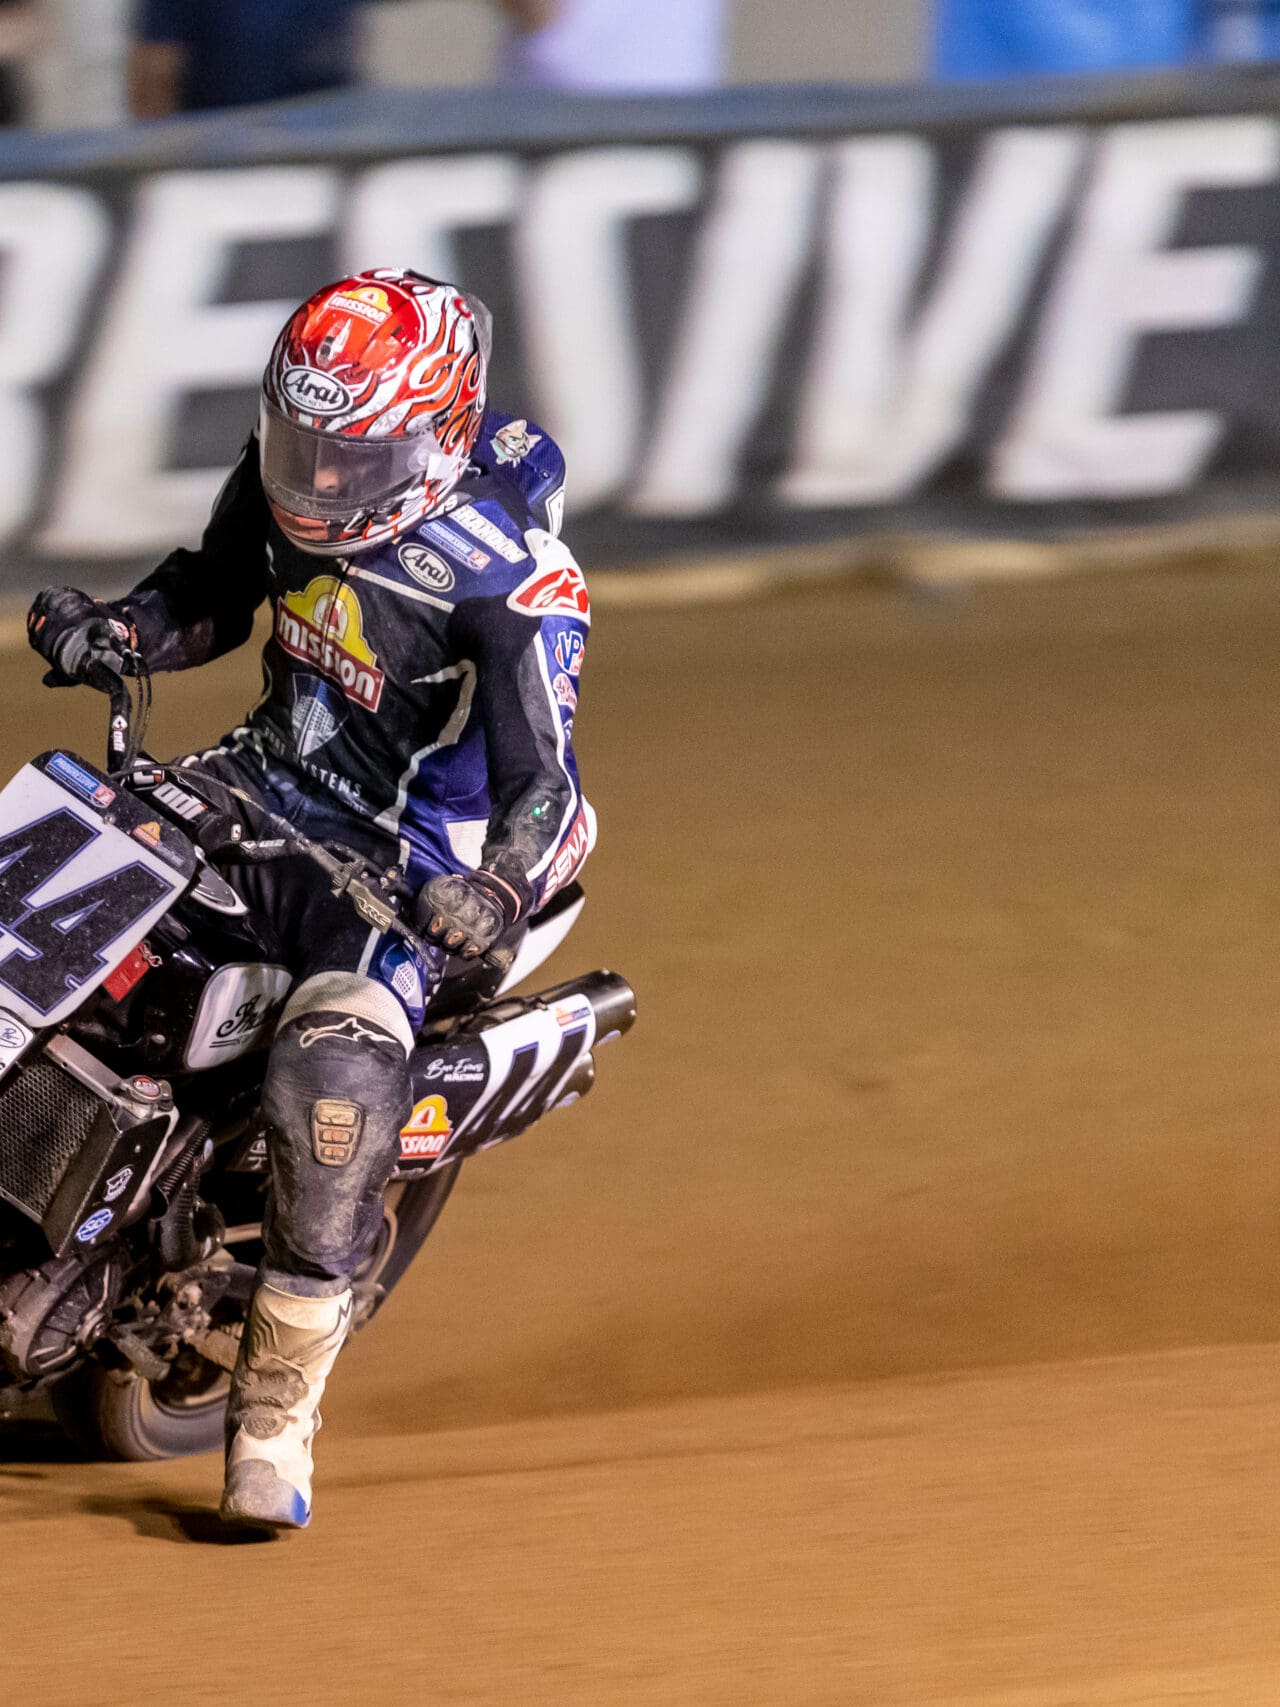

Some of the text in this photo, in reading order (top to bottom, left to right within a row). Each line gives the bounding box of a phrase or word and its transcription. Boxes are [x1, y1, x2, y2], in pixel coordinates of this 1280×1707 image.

[285, 372, 342, 405] Arai
[402, 552, 449, 584] Arai
[544, 822, 588, 899] SENA
